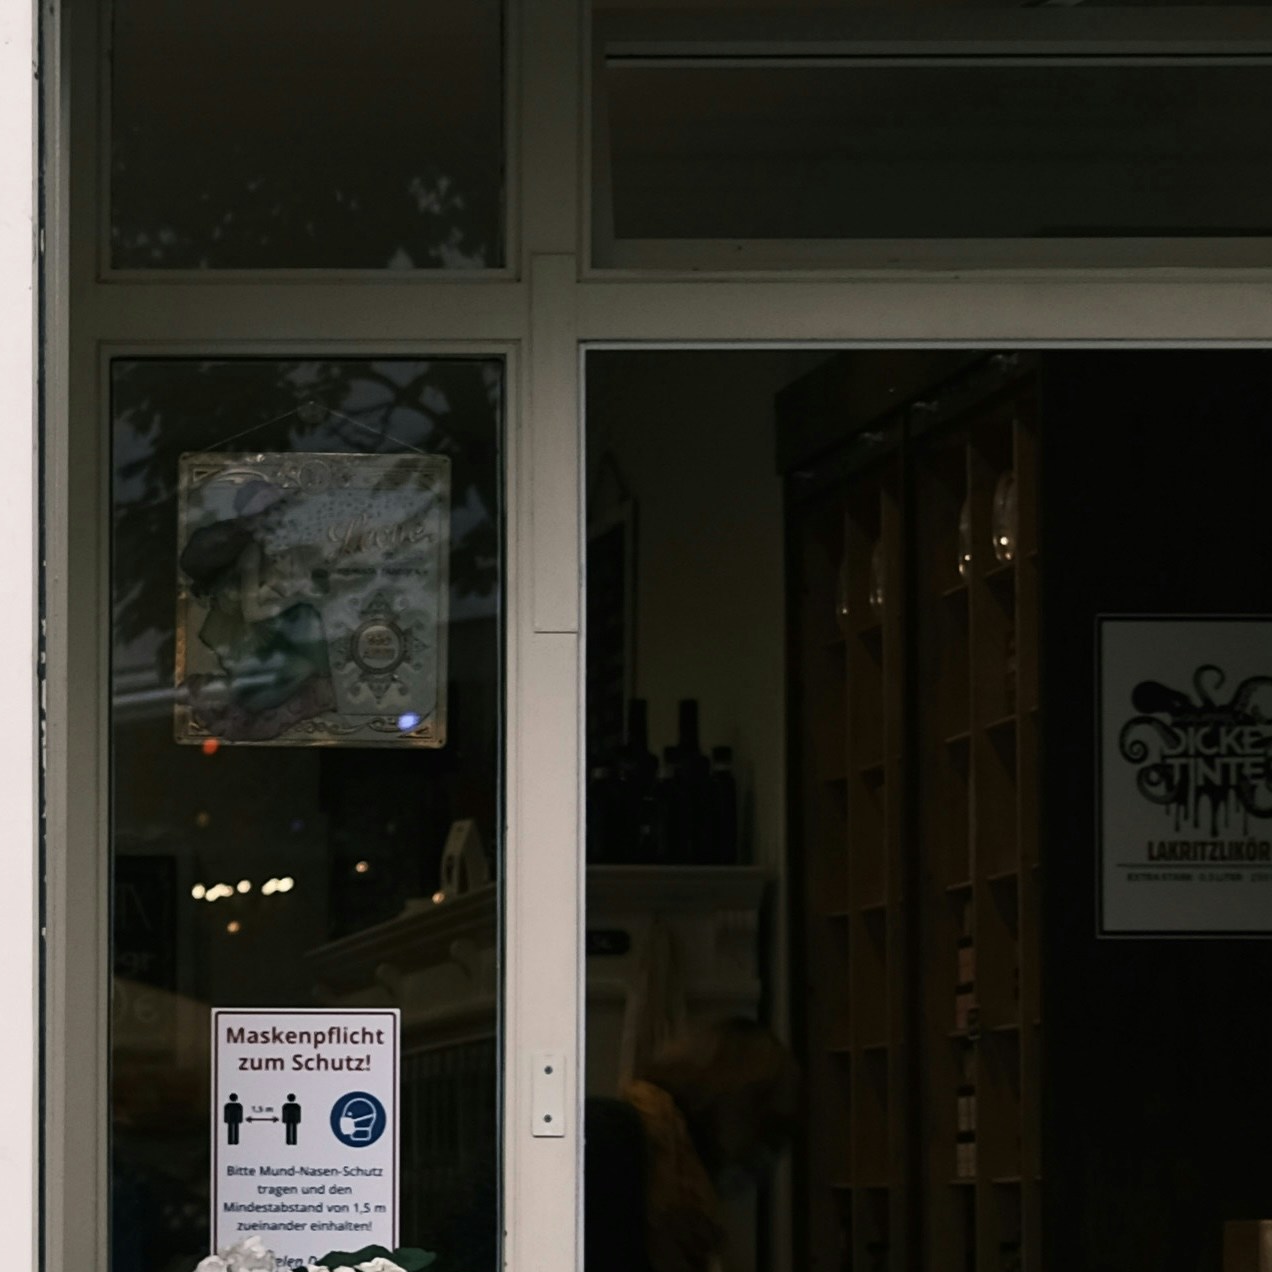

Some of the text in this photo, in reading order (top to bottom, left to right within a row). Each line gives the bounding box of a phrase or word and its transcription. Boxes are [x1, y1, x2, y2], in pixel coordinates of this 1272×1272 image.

[1148, 838, 1271, 861] LAKRITZLIKÖR
[227, 1026, 384, 1049] Maskenpflicht
[239, 1054, 371, 1071] zum Schutz!
[227, 1165, 383, 1177] Bitte Mund-Nasen-Schutz
[257, 1184, 352, 1196] tragen und den
[224, 1202, 386, 1215] Mindestabstand von 1,5 m
[236, 1221, 373, 1232] zueinander einhalten!
